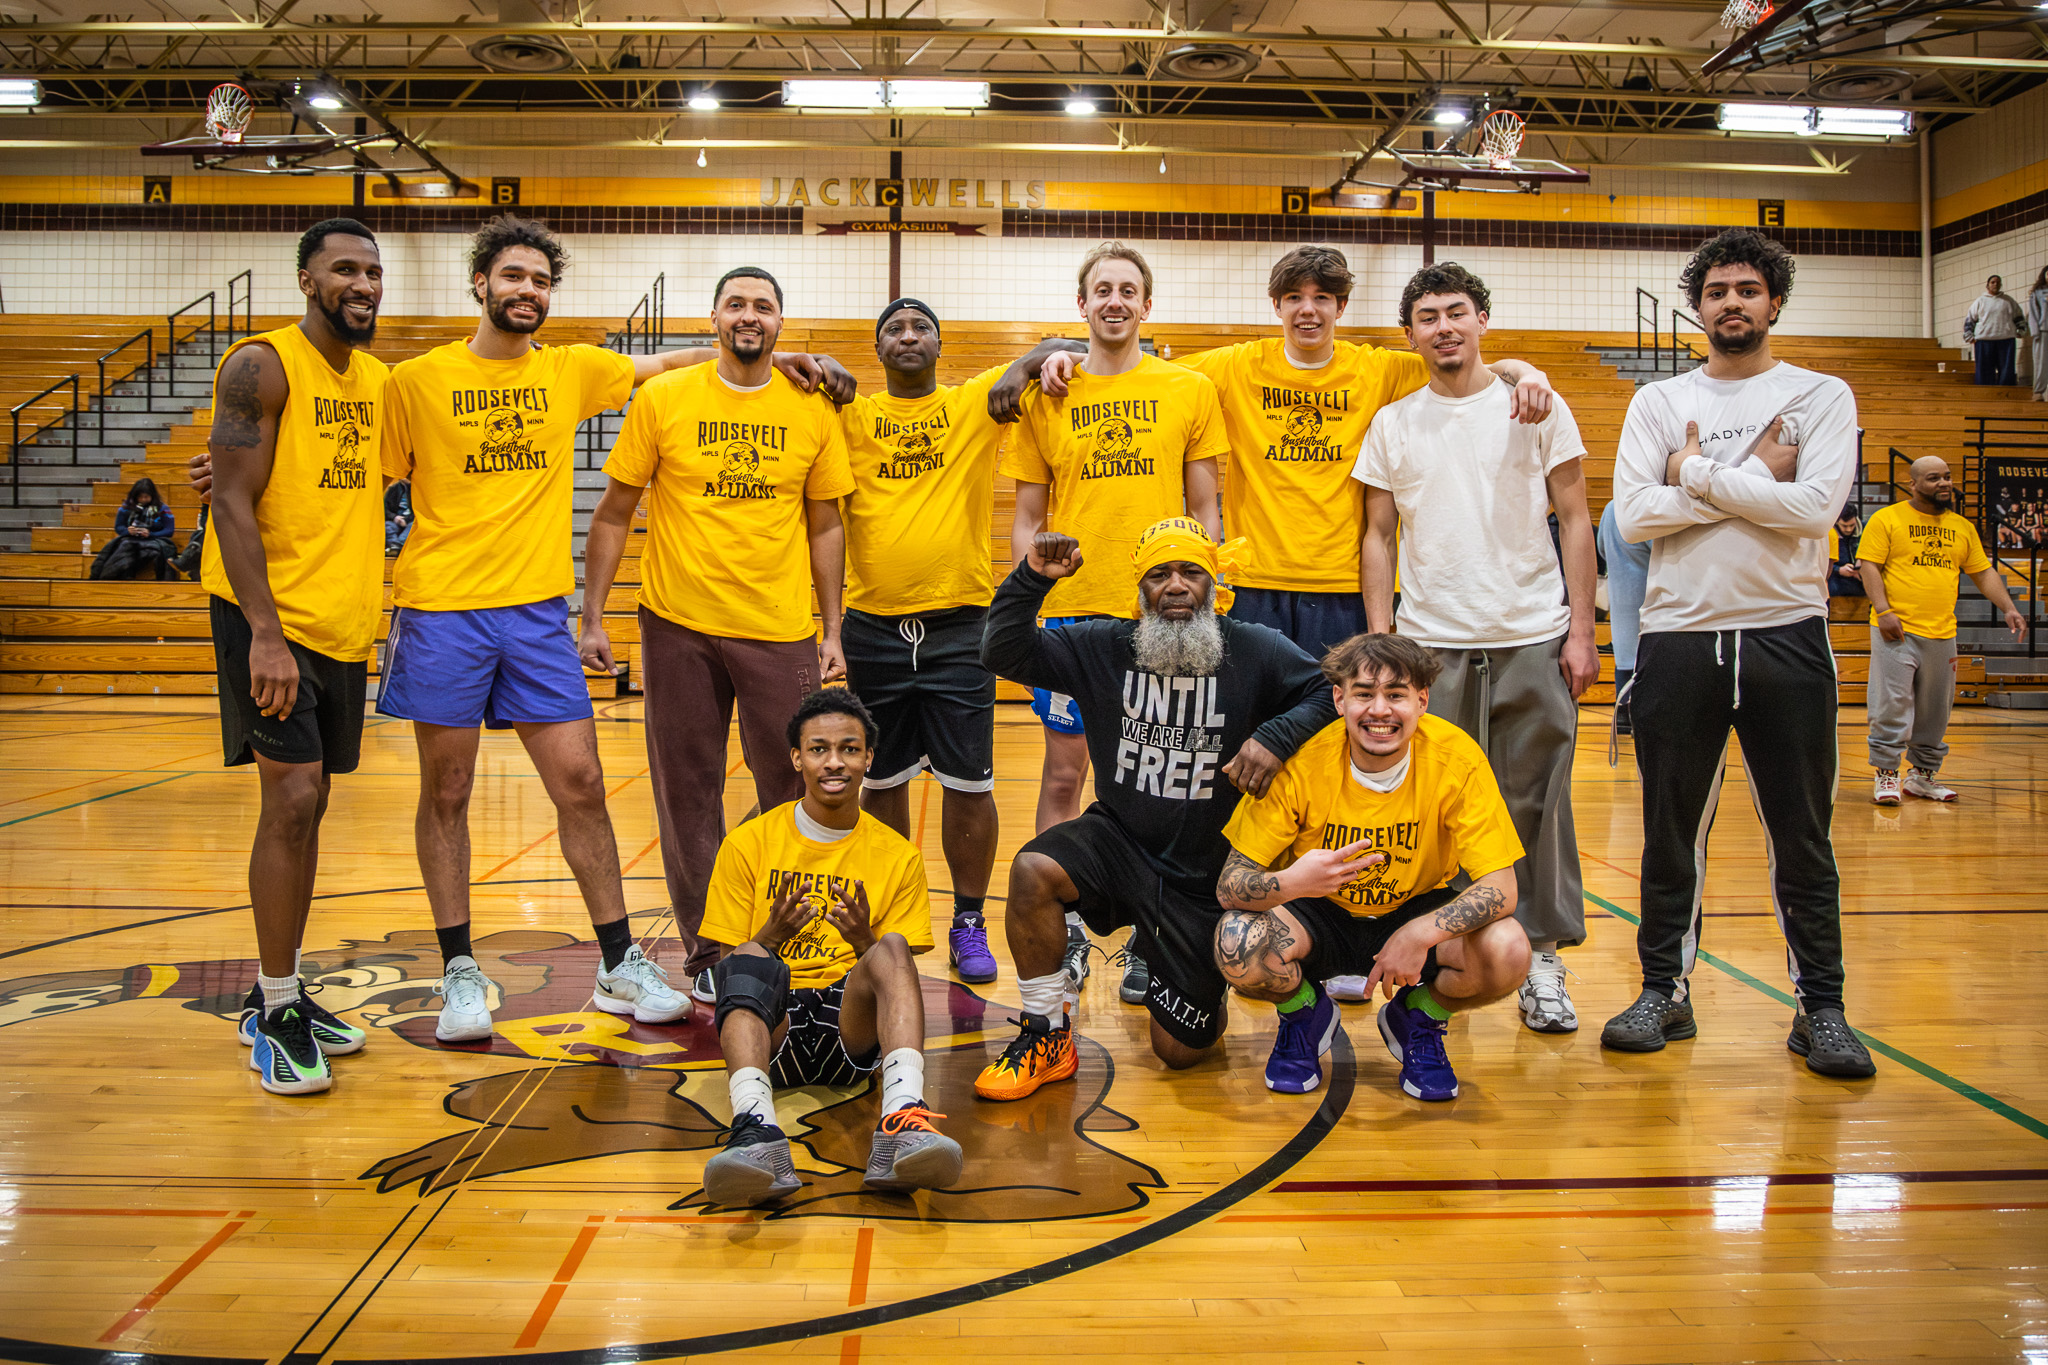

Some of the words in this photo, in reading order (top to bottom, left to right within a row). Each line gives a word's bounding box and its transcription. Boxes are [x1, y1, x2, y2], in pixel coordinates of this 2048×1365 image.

[148, 184, 166, 203] A
[498, 185, 513, 203] B
[760, 178, 870, 206] JACK
[909, 177, 1045, 208] WELLS
[881, 186, 898, 206] C
[1288, 194, 1304, 213] D
[1765, 207, 1778, 225] E
[851, 222, 949, 232] GYMNASIUM
[452, 388, 548, 417] ROOSEVELT
[1262, 386, 1350, 411] ROOSEVELT
[314, 396, 374, 429] ROOSEVELT
[1071, 400, 1159, 431] ROOSEVELT
[697, 421, 788, 452] ROOSEVELT
[1280, 434, 1331, 449] Basketball
[479, 440, 533, 458] Basketball
[1092, 447, 1142, 465] Basketball
[1264, 444, 1343, 461] ALUMNI
[463, 450, 548, 473] ALUMNI
[1080, 458, 1155, 480] ALUMNI
[717, 470, 768, 486] Basketball
[1999, 466, 2048, 477] ROOSEVE
[702, 482, 777, 499] ALUMNI
[1908, 524, 1956, 543] ROOSEVELT
[1122, 669, 1225, 728] UNTIL
[1121, 716, 1149, 745] WE
[1149, 724, 1184, 749] ARE
[1183, 724, 1223, 751] ALL
[1114, 737, 1219, 800] FREE
[1394, 855, 1412, 865] MINN
[780, 940, 840, 960] UMNI
